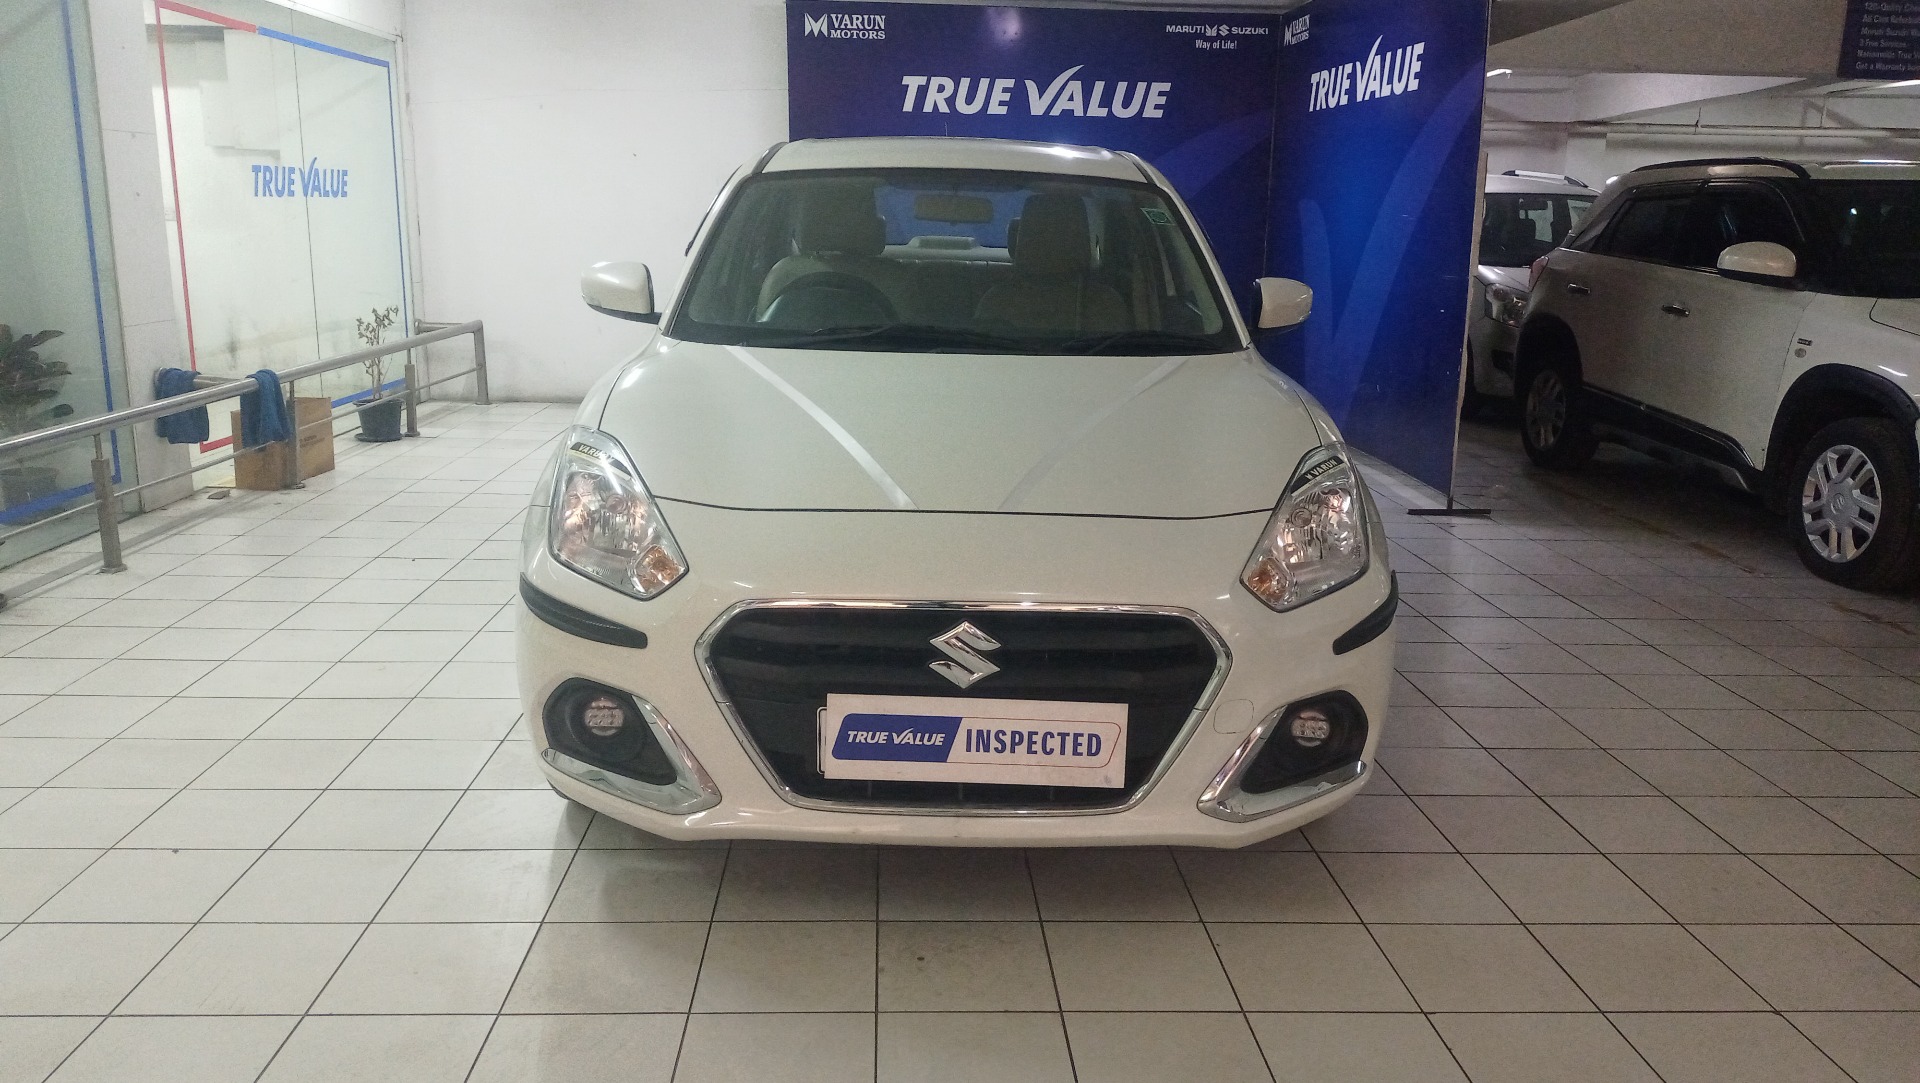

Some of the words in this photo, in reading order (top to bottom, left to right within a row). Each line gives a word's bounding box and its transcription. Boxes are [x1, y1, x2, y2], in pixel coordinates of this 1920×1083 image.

[830, 13, 886, 30] VARUN
[1165, 25, 1204, 33] MARUTI
[1231, 26, 1269, 35] SUZUKI
[1292, 14, 1310, 35] VARUN
[830, 29, 886, 39] MOTORS
[1195, 40, 1210, 51] Way
[1212, 40, 1220, 49] of
[1221, 40, 1238, 50] Life!
[1309, 62, 1354, 112] TRUE
[1355, 34, 1425, 102] VALUE
[901, 75, 1016, 115] TRUE
[1024, 64, 1172, 119] VALUE
[252, 164, 296, 198] TRUE
[298, 157, 348, 198] VALUE
[578, 444, 611, 462] VARU
[1310, 459, 1338, 476] VARUN
[847, 730, 888, 745] TRUE
[892, 727, 946, 746] VALUE
[965, 728, 1102, 757] INSPECTED
